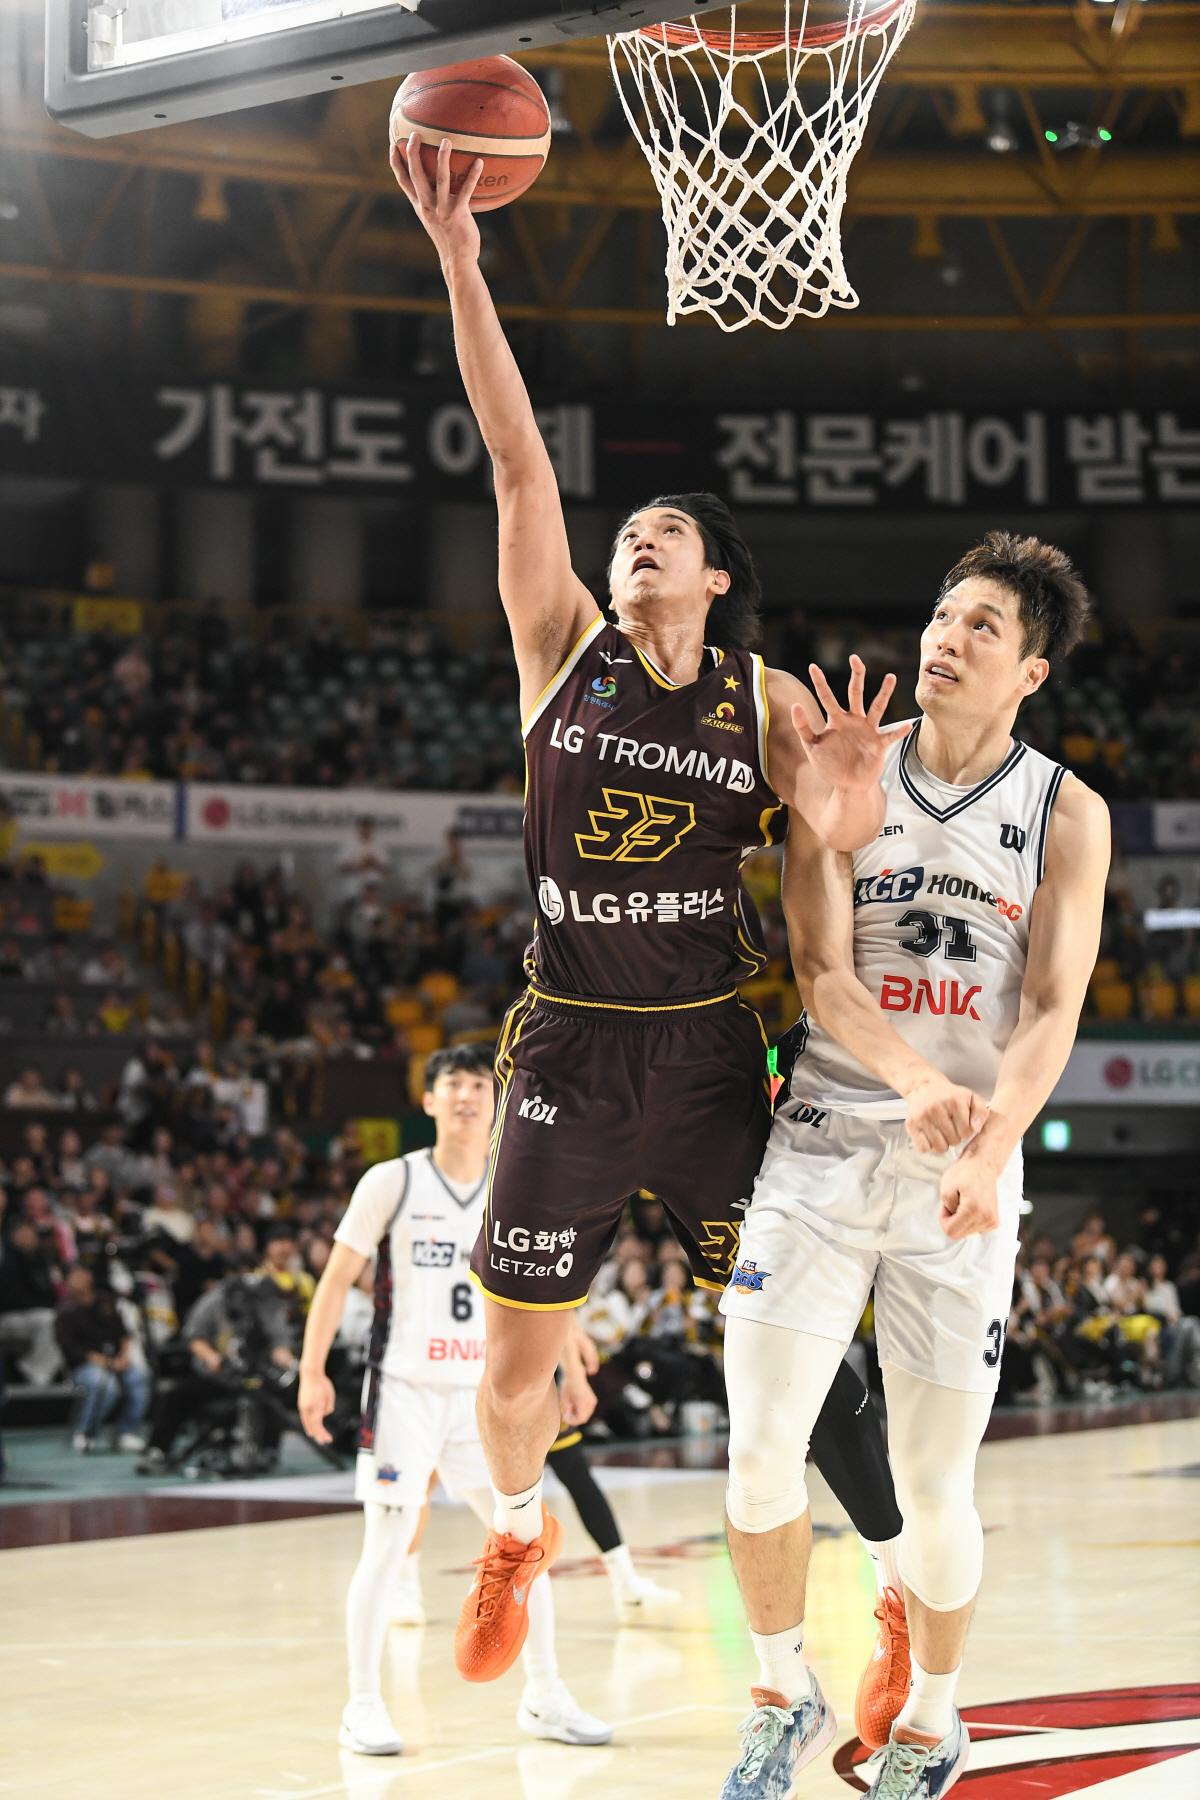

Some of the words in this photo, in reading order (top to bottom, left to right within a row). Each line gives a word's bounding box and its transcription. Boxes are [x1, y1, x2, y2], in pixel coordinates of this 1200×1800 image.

[155, 383, 415, 483] 가전도
[715, 409, 1049, 505] 전문케어
[550, 718, 586, 754] LG
[597, 732, 727, 784] TROMM
[701, 716, 744, 734] SAKERS
[575, 787, 697, 862] 33
[895, 909, 977, 962] 31
[880, 974, 982, 1021] BNK
[451, 1283, 472, 1322] 6
